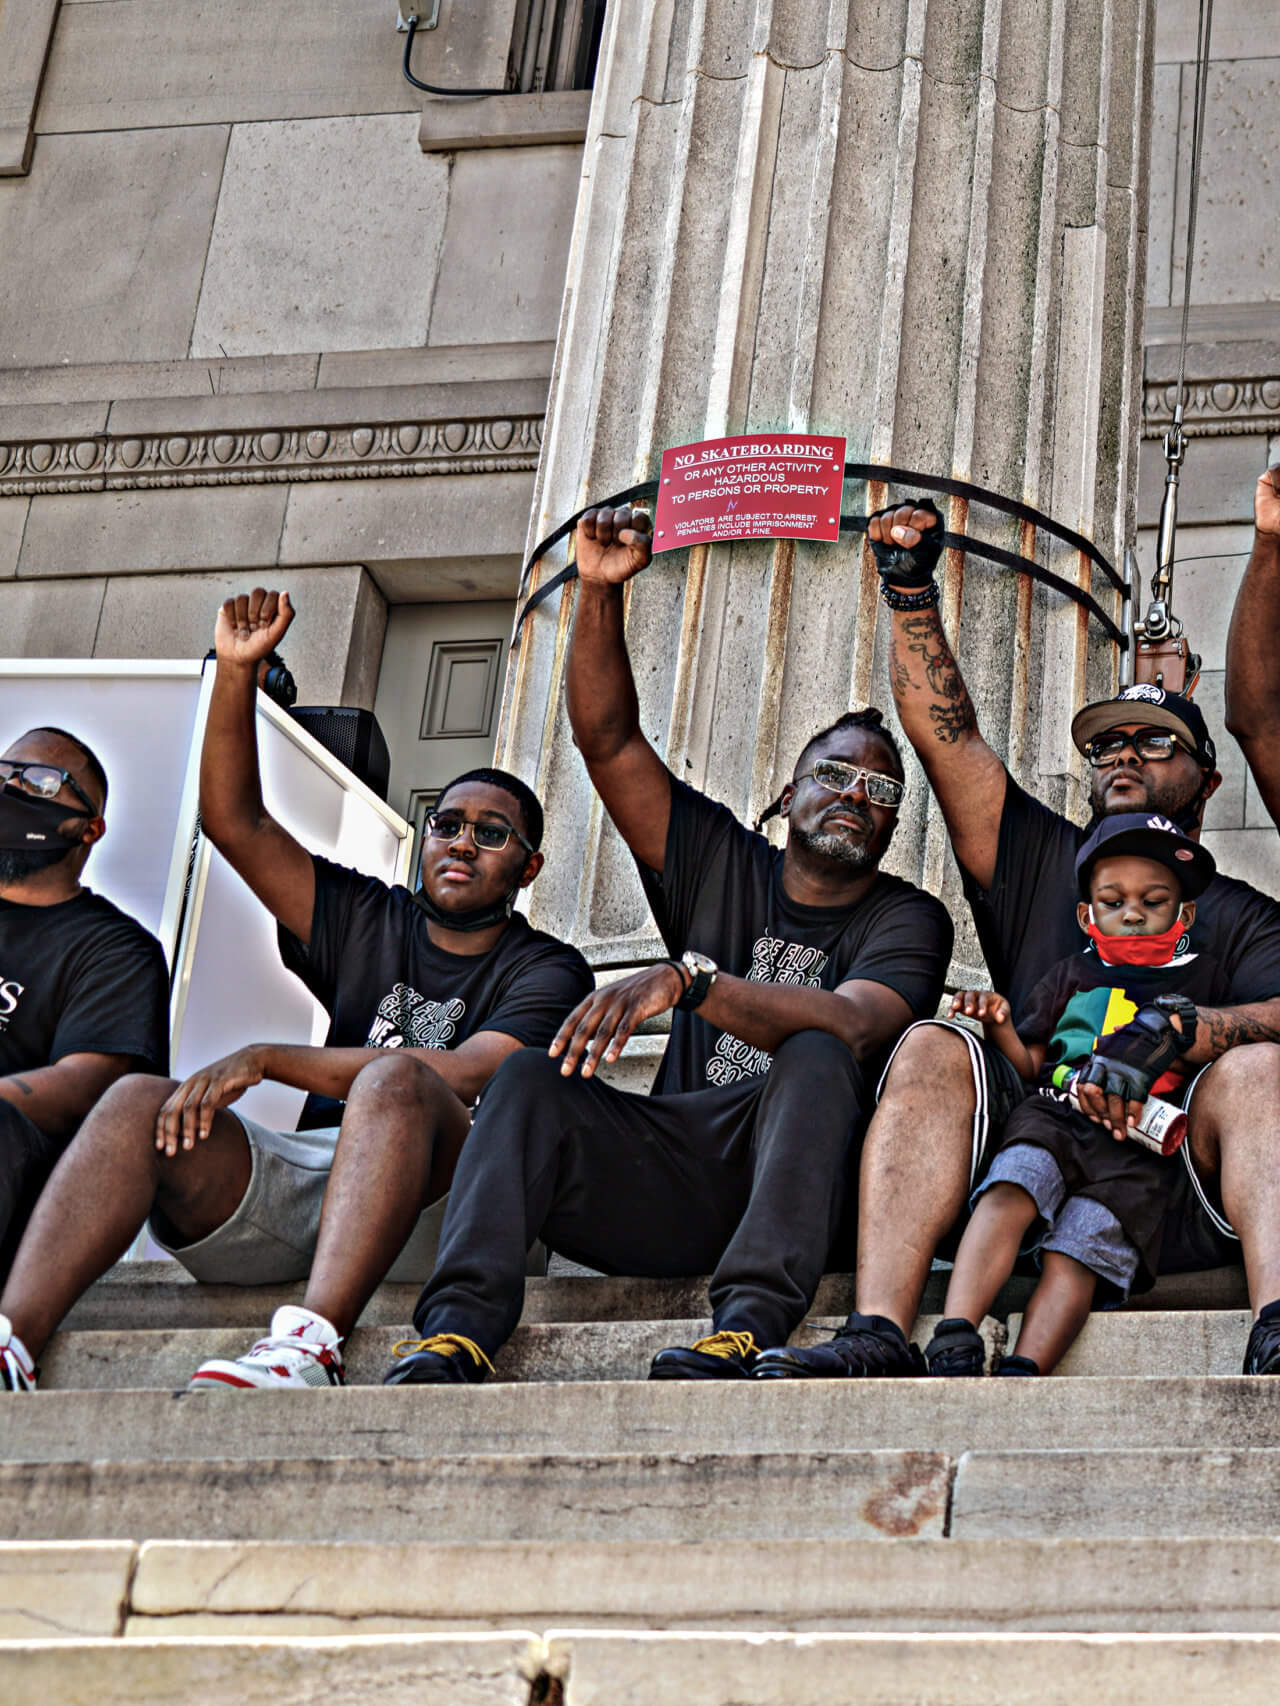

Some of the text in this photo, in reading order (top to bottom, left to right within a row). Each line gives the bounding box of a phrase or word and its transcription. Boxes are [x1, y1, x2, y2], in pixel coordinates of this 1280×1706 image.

[674, 444, 834, 468] NO SKATEBOARDING
[684, 462, 822, 481] OR ANY OTHER ACTIVITY
[714, 473, 785, 486] HAZARDOUS
[672, 484, 829, 504] TO PERSONS OR PROPERTY
[675, 517, 715, 530] VIOLATORS
[718, 514, 733, 522] ARE
[735, 513, 771, 521] SUBJECT
[676, 521, 814, 537] PENALTIES INCLUDE IMPRISONMENT
